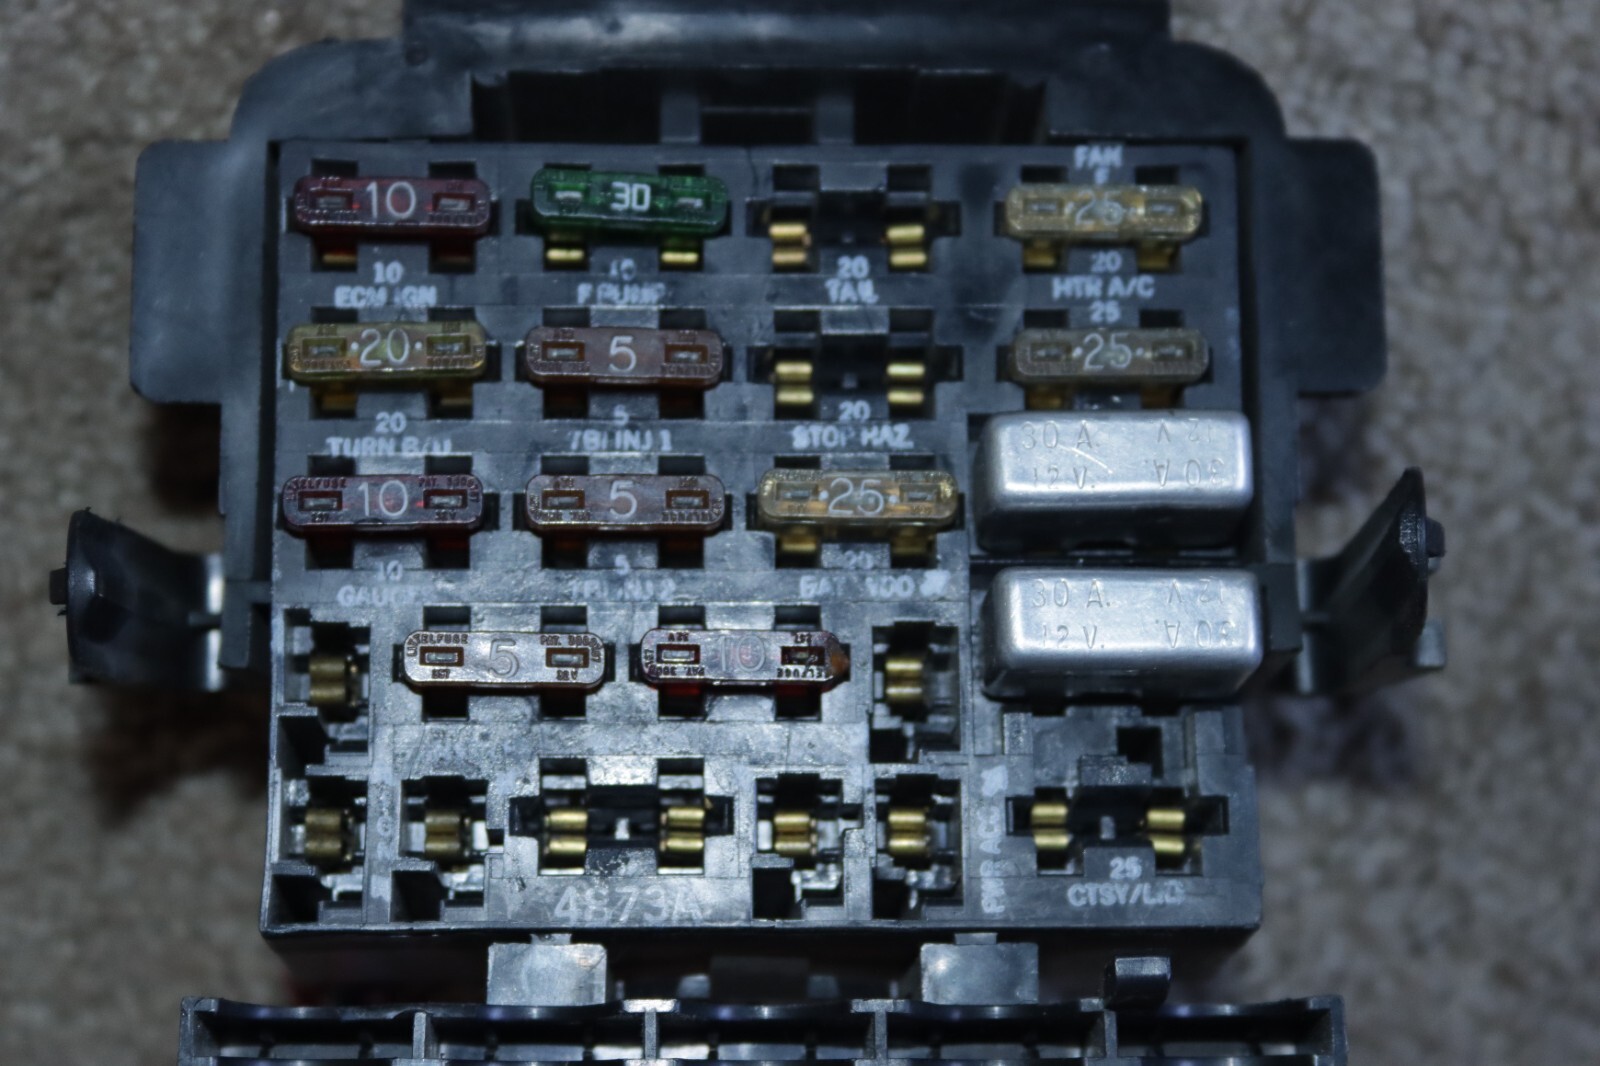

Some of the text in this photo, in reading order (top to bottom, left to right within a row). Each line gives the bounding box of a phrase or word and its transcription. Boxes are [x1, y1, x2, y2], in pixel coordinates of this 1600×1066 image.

[1073, 145, 1123, 169] FAN
[366, 181, 416, 219] 10
[610, 181, 651, 212] 30
[1074, 189, 1124, 226] 25
[373, 260, 404, 284] 10
[837, 255, 869, 279] 20
[1090, 251, 1122, 274] 20
[334, 285, 387, 308] ECM
[1108, 275, 1155, 298] A/C
[1090, 300, 1121, 323] 25
[360, 328, 409, 366] 20
[608, 335, 637, 373] 5
[1083, 332, 1132, 370] 25
[375, 411, 407, 433] 20
[839, 400, 870, 423] 20
[325, 436, 396, 457] TURN
[791, 423, 914, 450] STOP HAZ
[1020, 420, 1058, 449] 30
[358, 479, 409, 517] 10
[608, 480, 637, 519] 5
[828, 477, 884, 516] 25
[376, 559, 403, 581] 10
[1031, 578, 1069, 608] 30
[487, 638, 519, 678] 5
[720, 635, 765, 672] 10
[1110, 856, 1143, 880] 25
